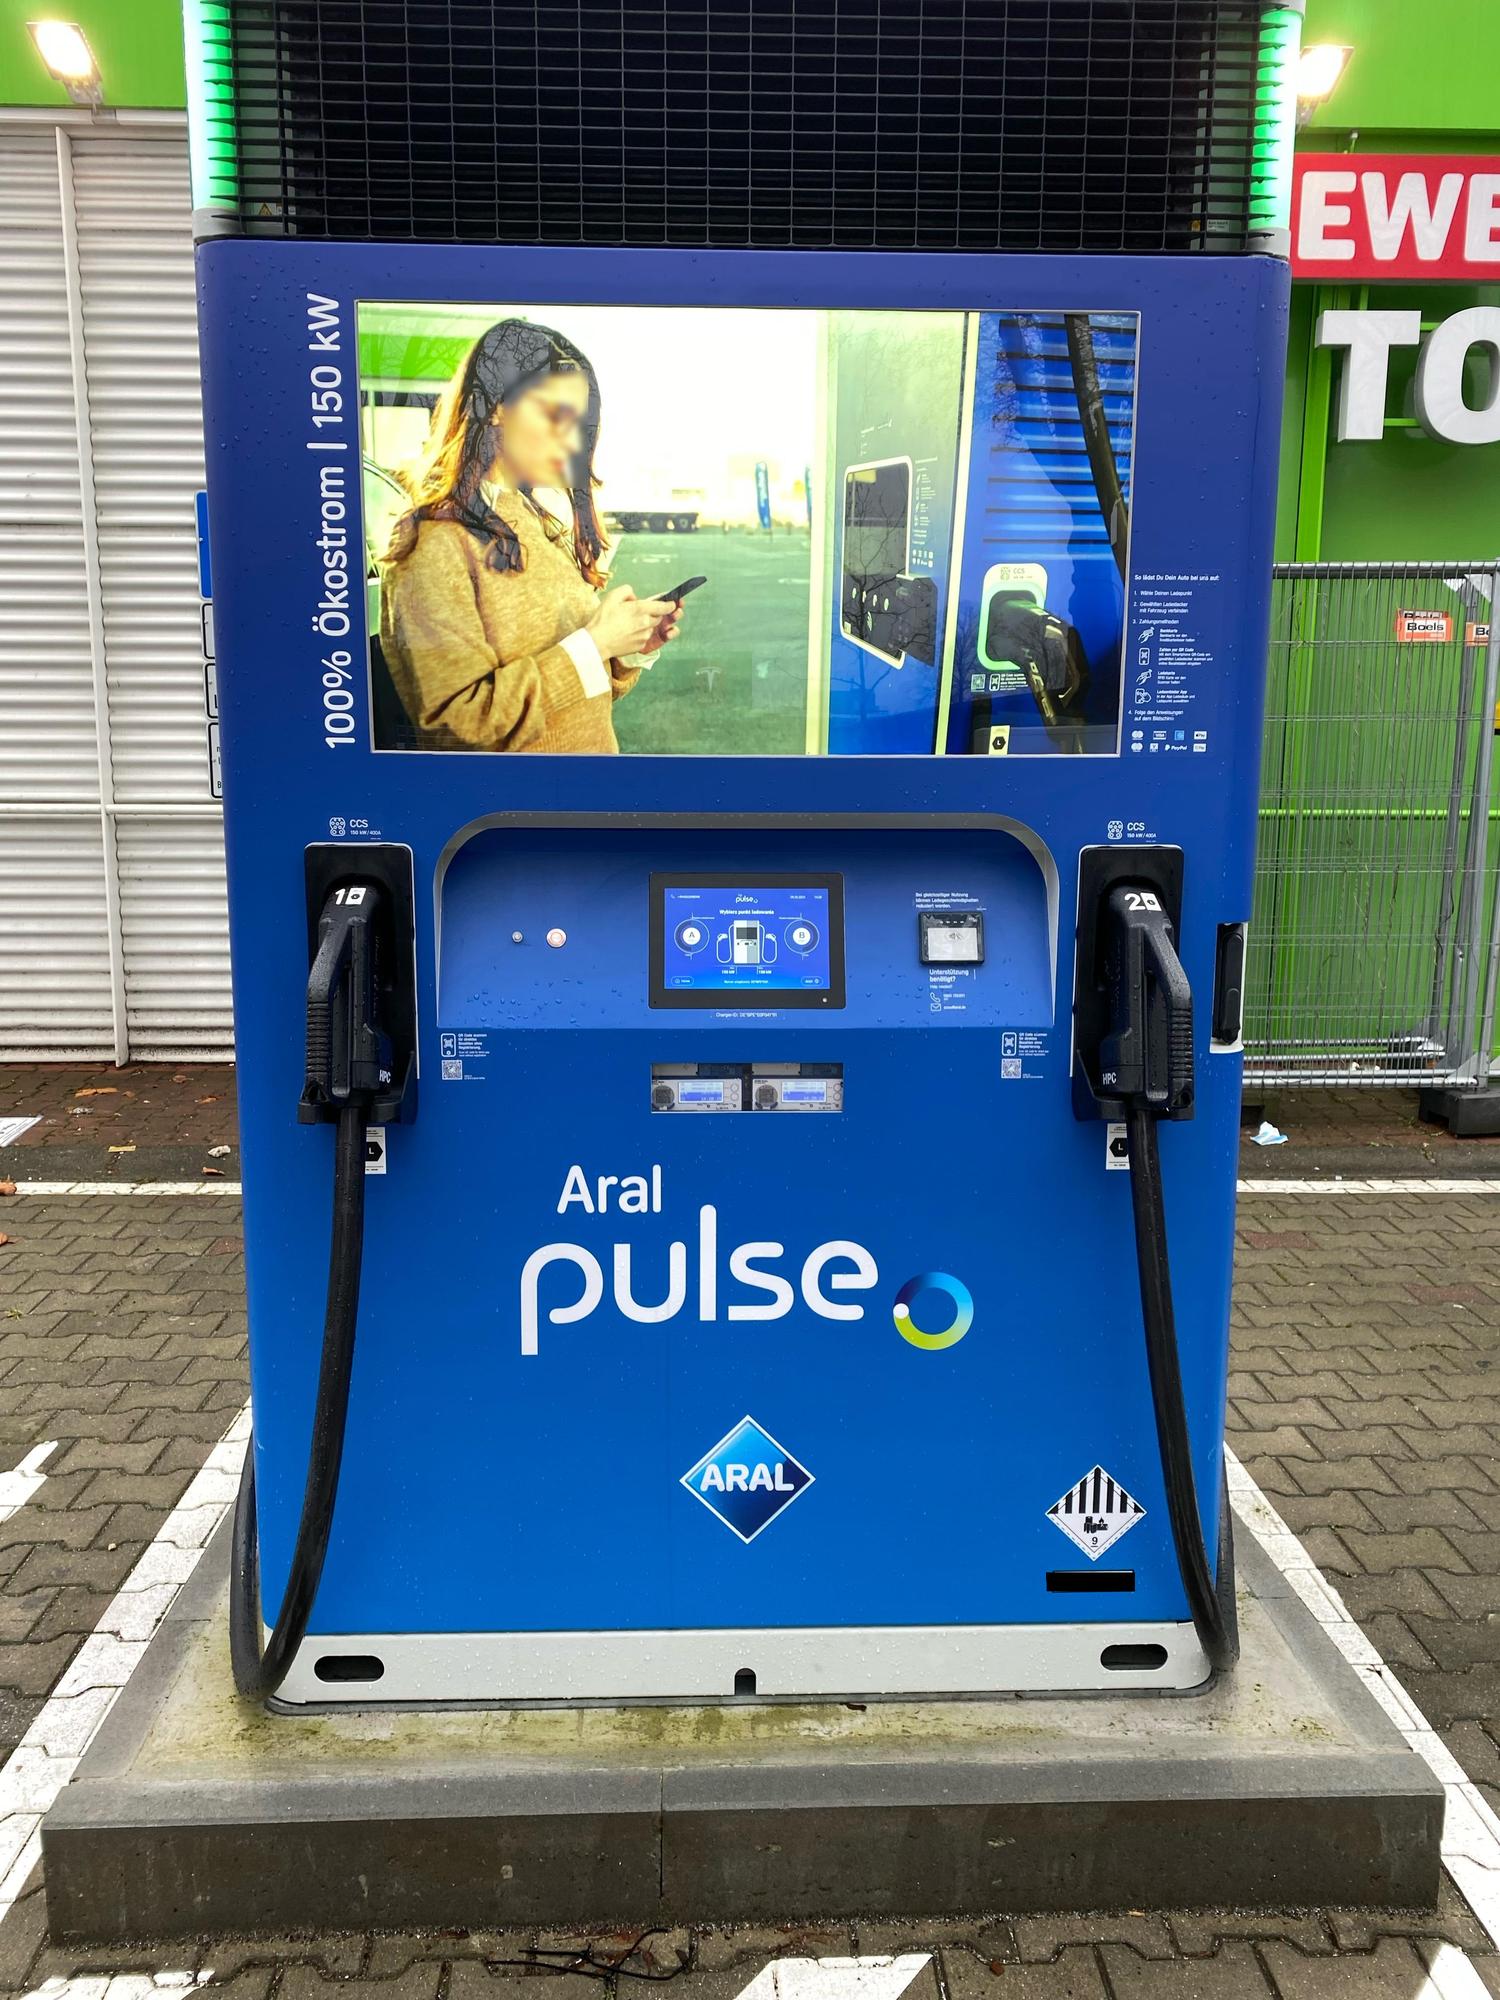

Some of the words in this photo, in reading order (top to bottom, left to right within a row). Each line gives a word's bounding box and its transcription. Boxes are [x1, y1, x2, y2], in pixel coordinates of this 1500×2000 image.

[306, 293, 340, 351] kW
[310, 366, 343, 428] 150
[312, 466, 350, 637] Ökostrom
[1407, 622, 1444, 631] Boels
[321, 650, 356, 749] 100%
[350, 820, 368, 828] CCS
[1127, 822, 1145, 831] CCS
[335, 888, 346, 905] 1
[1124, 893, 1146, 911] 2
[379, 1069, 391, 1083] HPC
[1103, 1072, 1117, 1085] HPC
[557, 1164, 662, 1214] Aral
[520, 1204, 878, 1356] pulse
[700, 1462, 794, 1492] ARAL
